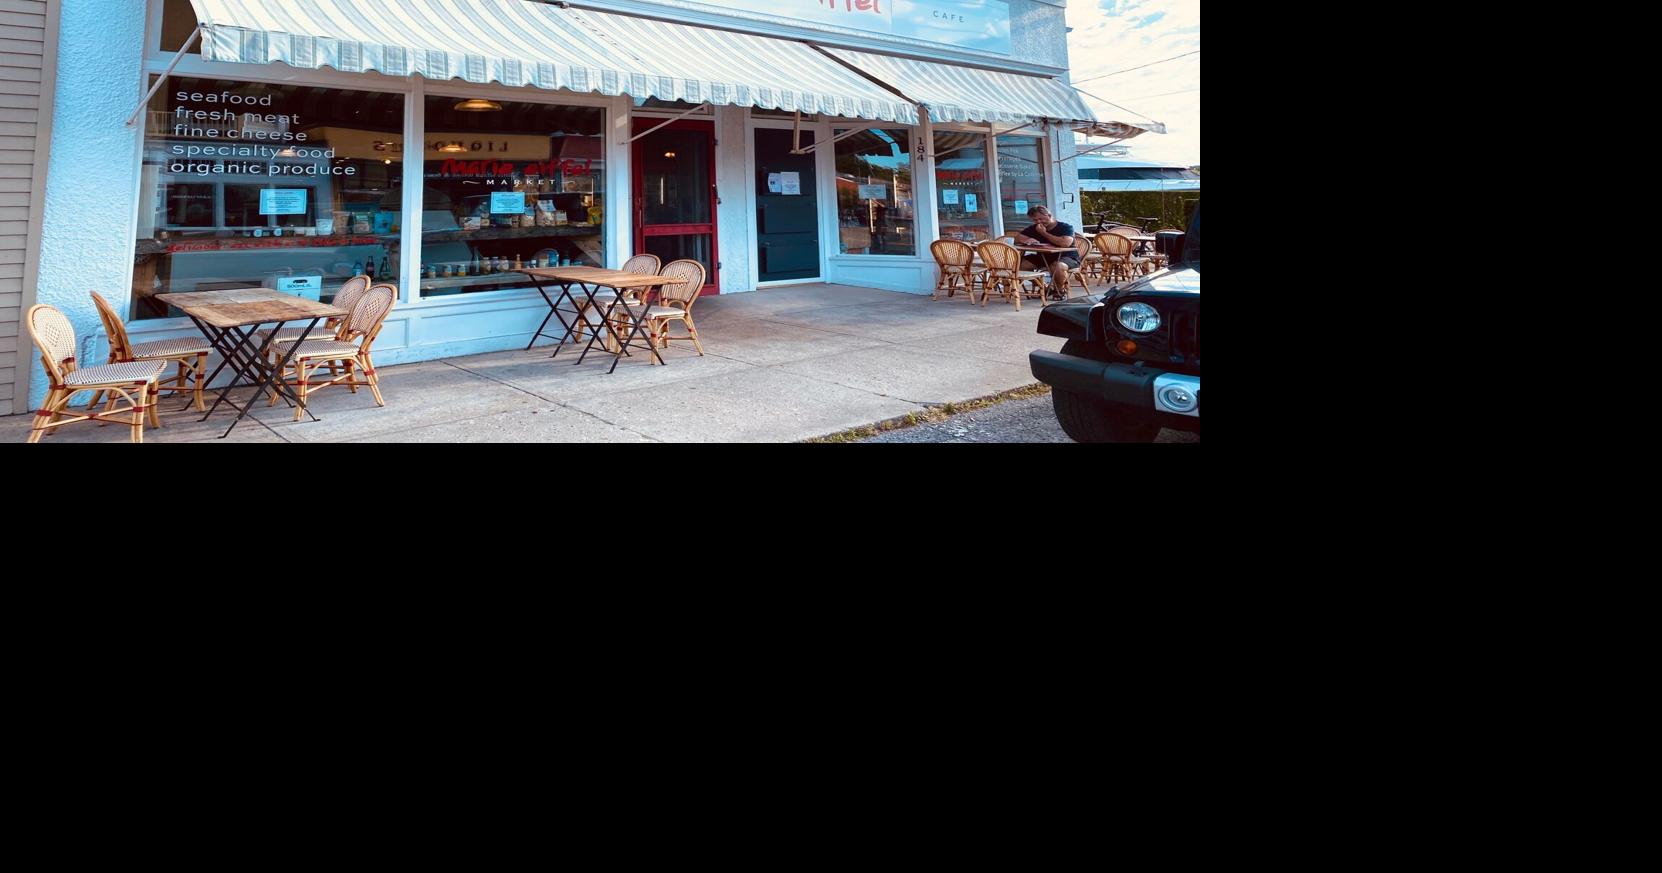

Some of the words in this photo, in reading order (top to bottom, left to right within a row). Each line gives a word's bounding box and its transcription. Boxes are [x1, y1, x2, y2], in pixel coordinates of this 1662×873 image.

[932, 10, 965, 23] CAFE
[176, 90, 272, 106] seafood
[175, 106, 235, 121] fresh
[243, 112, 300, 125] meat
[173, 124, 219, 138] fine
[227, 126, 307, 141] cheese
[172, 143, 281, 160] specialty
[286, 146, 336, 159] food
[917, 136, 926, 162] 184
[170, 160, 261, 176] organic
[268, 162, 356, 176] produce
